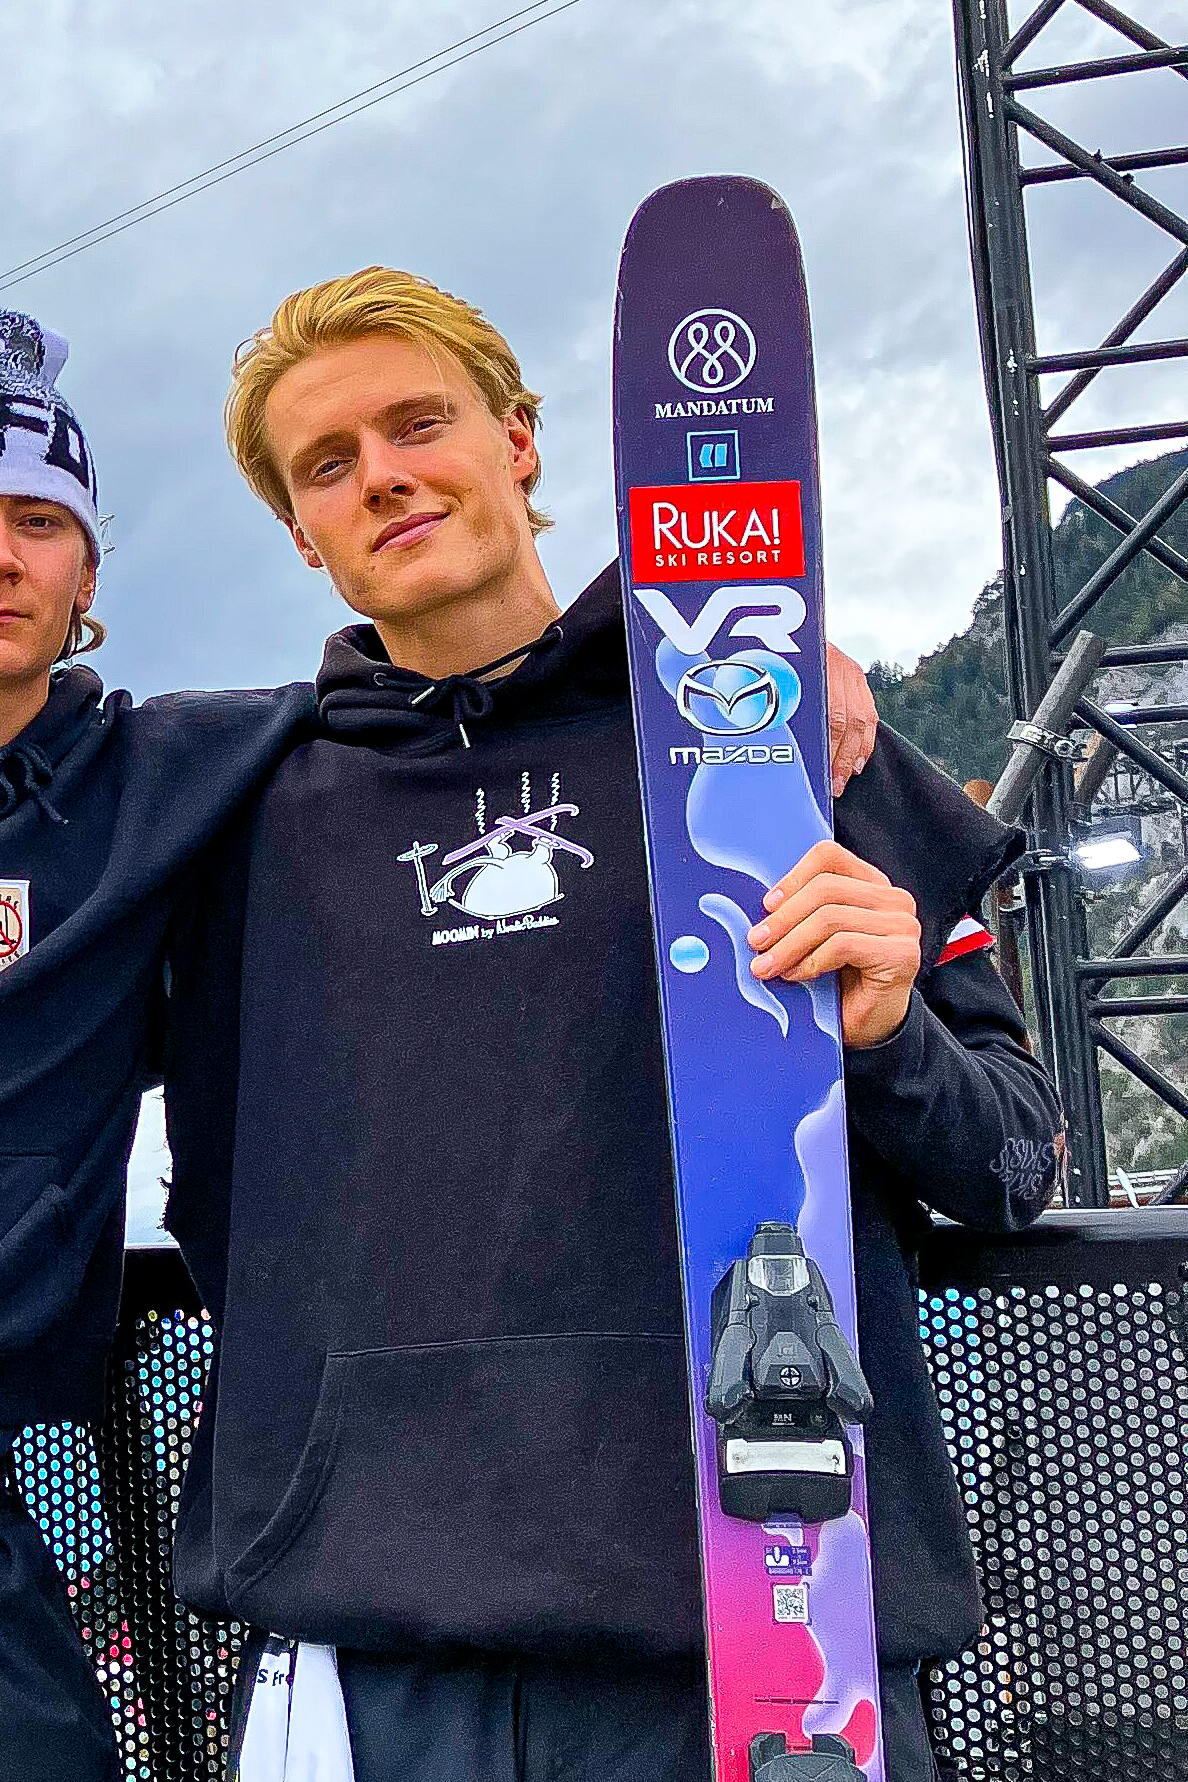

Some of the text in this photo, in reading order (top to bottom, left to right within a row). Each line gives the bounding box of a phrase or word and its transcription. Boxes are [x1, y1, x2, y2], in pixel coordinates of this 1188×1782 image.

[654, 397, 774, 419] MANDATUM
[652, 502, 781, 550] RUKA!
[655, 549, 781, 567] SKI RESORT
[632, 585, 808, 656] VR
